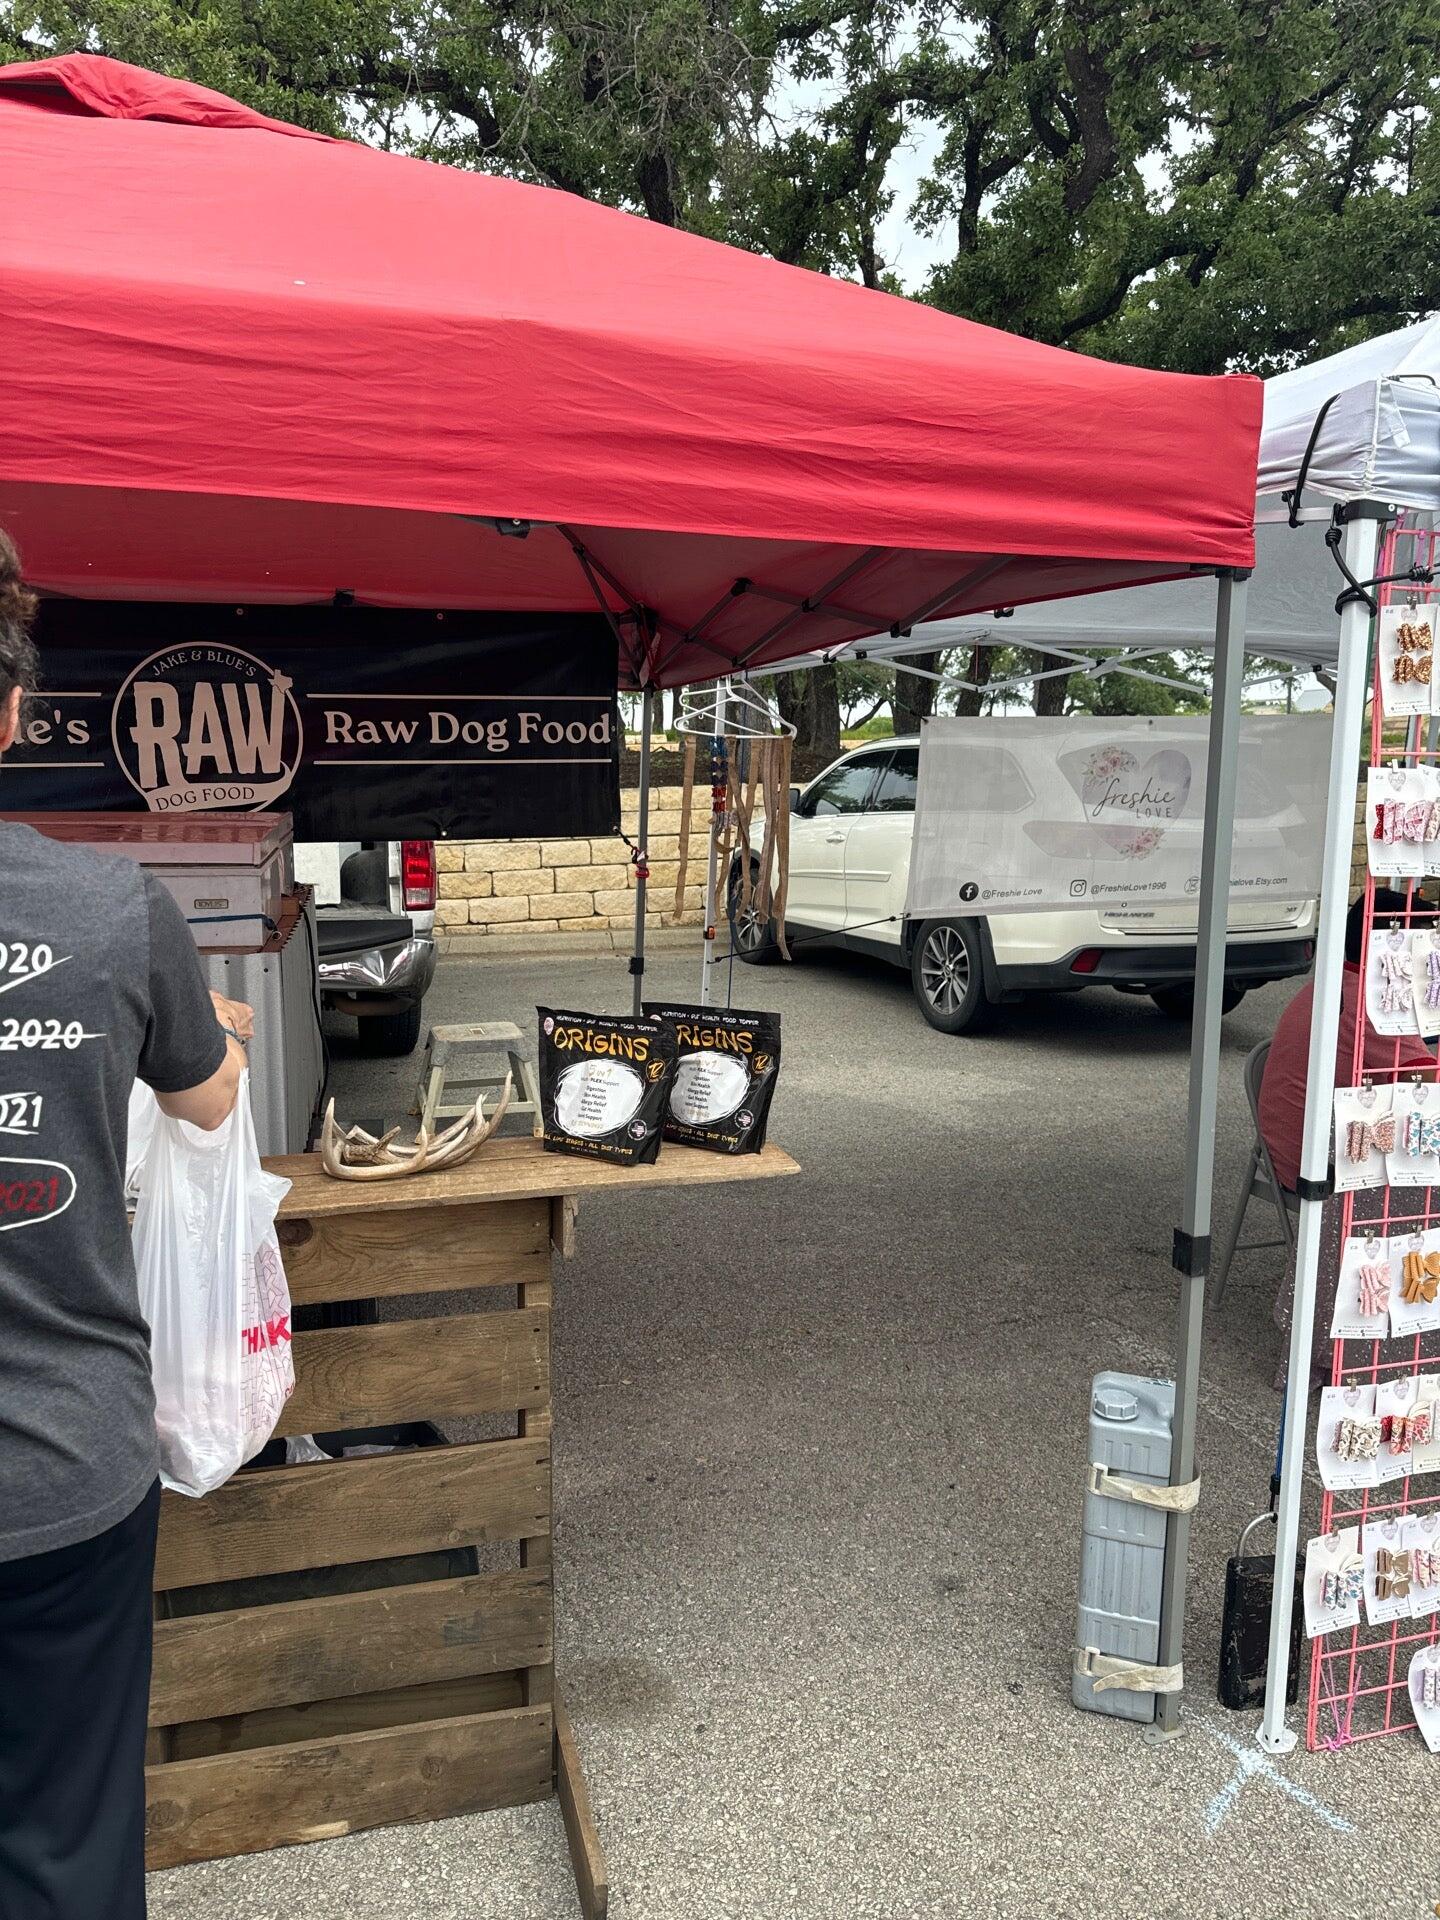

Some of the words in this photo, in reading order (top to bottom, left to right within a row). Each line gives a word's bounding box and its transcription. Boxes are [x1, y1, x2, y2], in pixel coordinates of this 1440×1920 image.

[152, 651, 187, 677] JAKE
[191, 649, 202, 661] &
[207, 650, 257, 677] BLUE'S
[129, 681, 286, 789] RAW
[323, 711, 419, 744] Raw
[428, 711, 510, 752] Dog
[518, 712, 611, 745] Food
[155, 790, 197, 811] DOG
[203, 787, 255, 802] FOOD
[1092, 777, 1175, 817] freshie
[1136, 807, 1172, 819] LOVE
[981, 888, 1020, 900] @Freshie
[1023, 887, 1042, 896] Love
[1090, 881, 1167, 895] @FreshieLove1996
[0, 1019, 84, 1051] 2020
[554, 1027, 650, 1061] ORIGINS
[676, 1024, 753, 1054] RIGINS
